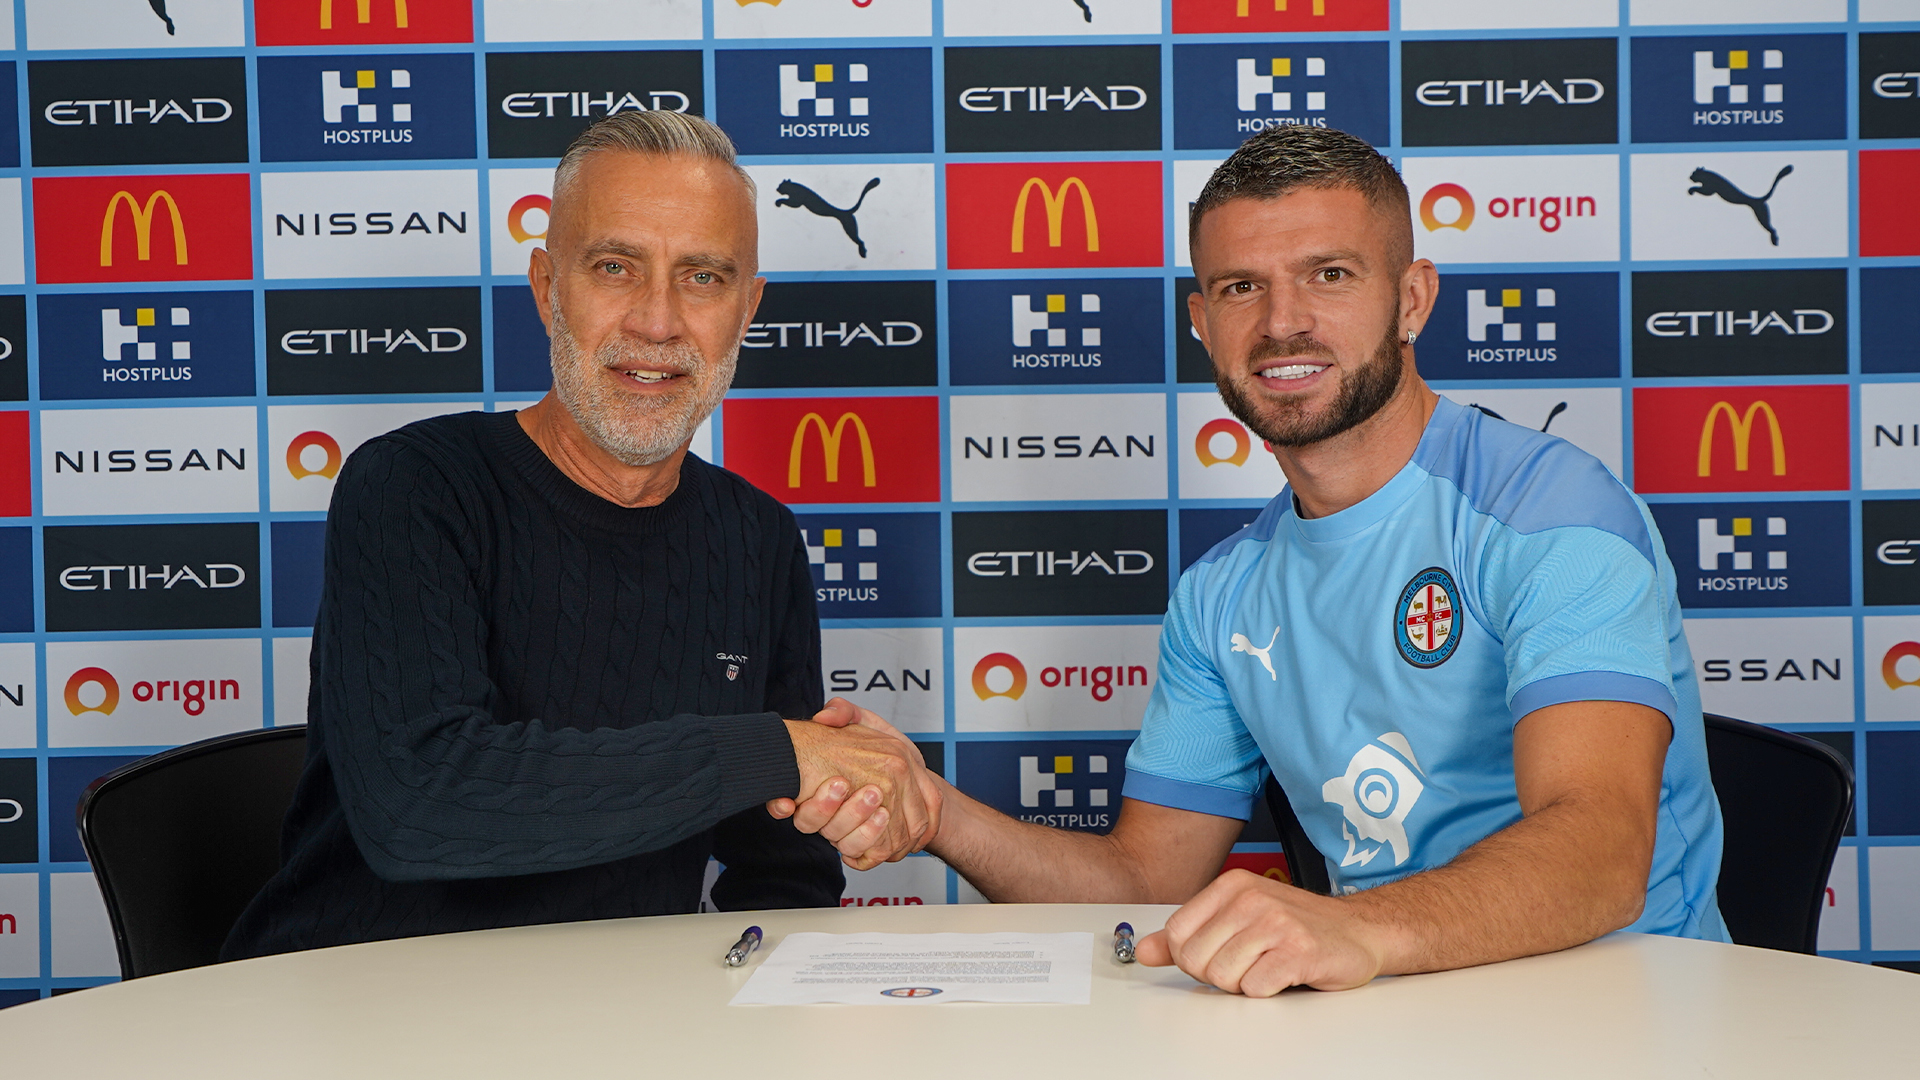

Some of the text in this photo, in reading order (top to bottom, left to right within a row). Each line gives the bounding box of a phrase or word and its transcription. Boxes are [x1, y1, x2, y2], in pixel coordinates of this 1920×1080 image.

[960, 86, 1147, 111] ETIHAD
[1416, 78, 1604, 105] ETIHAD
[45, 98, 232, 125] ETIHAD
[502, 91, 690, 117] ETIHAD
[1694, 110, 1783, 125] HOSTPLUS
[324, 129, 412, 144] HOSTPLUS
[780, 123, 869, 137] HOSTPLUS
[277, 212, 466, 236] NISSAN
[1488, 196, 1596, 232] origin
[741, 322, 923, 347] ETIHAD
[1646, 310, 1834, 336] ETIHAD
[281, 328, 467, 354] ETIHAD
[1013, 353, 1102, 367] HOSTPLUS
[1468, 348, 1557, 362] HOSTPLUS
[103, 367, 192, 381] HOSTPLUS
[965, 435, 1154, 458] NISSAN
[56, 449, 246, 473] NISSAN
[968, 551, 1154, 576] ETIHAD
[60, 564, 245, 590] ETIHAD
[1404, 574, 1454, 603] MELBOURNE CITY
[1699, 577, 1788, 591] HOSTPLUS
[817, 588, 878, 602] STPLUS
[716, 652, 748, 664] GANT
[1404, 635, 1456, 662] FOOTBALL CLUB
[830, 669, 930, 692] SAN
[1704, 658, 1841, 682] SSAN
[1040, 666, 1148, 702] origin
[132, 679, 240, 716] origin
